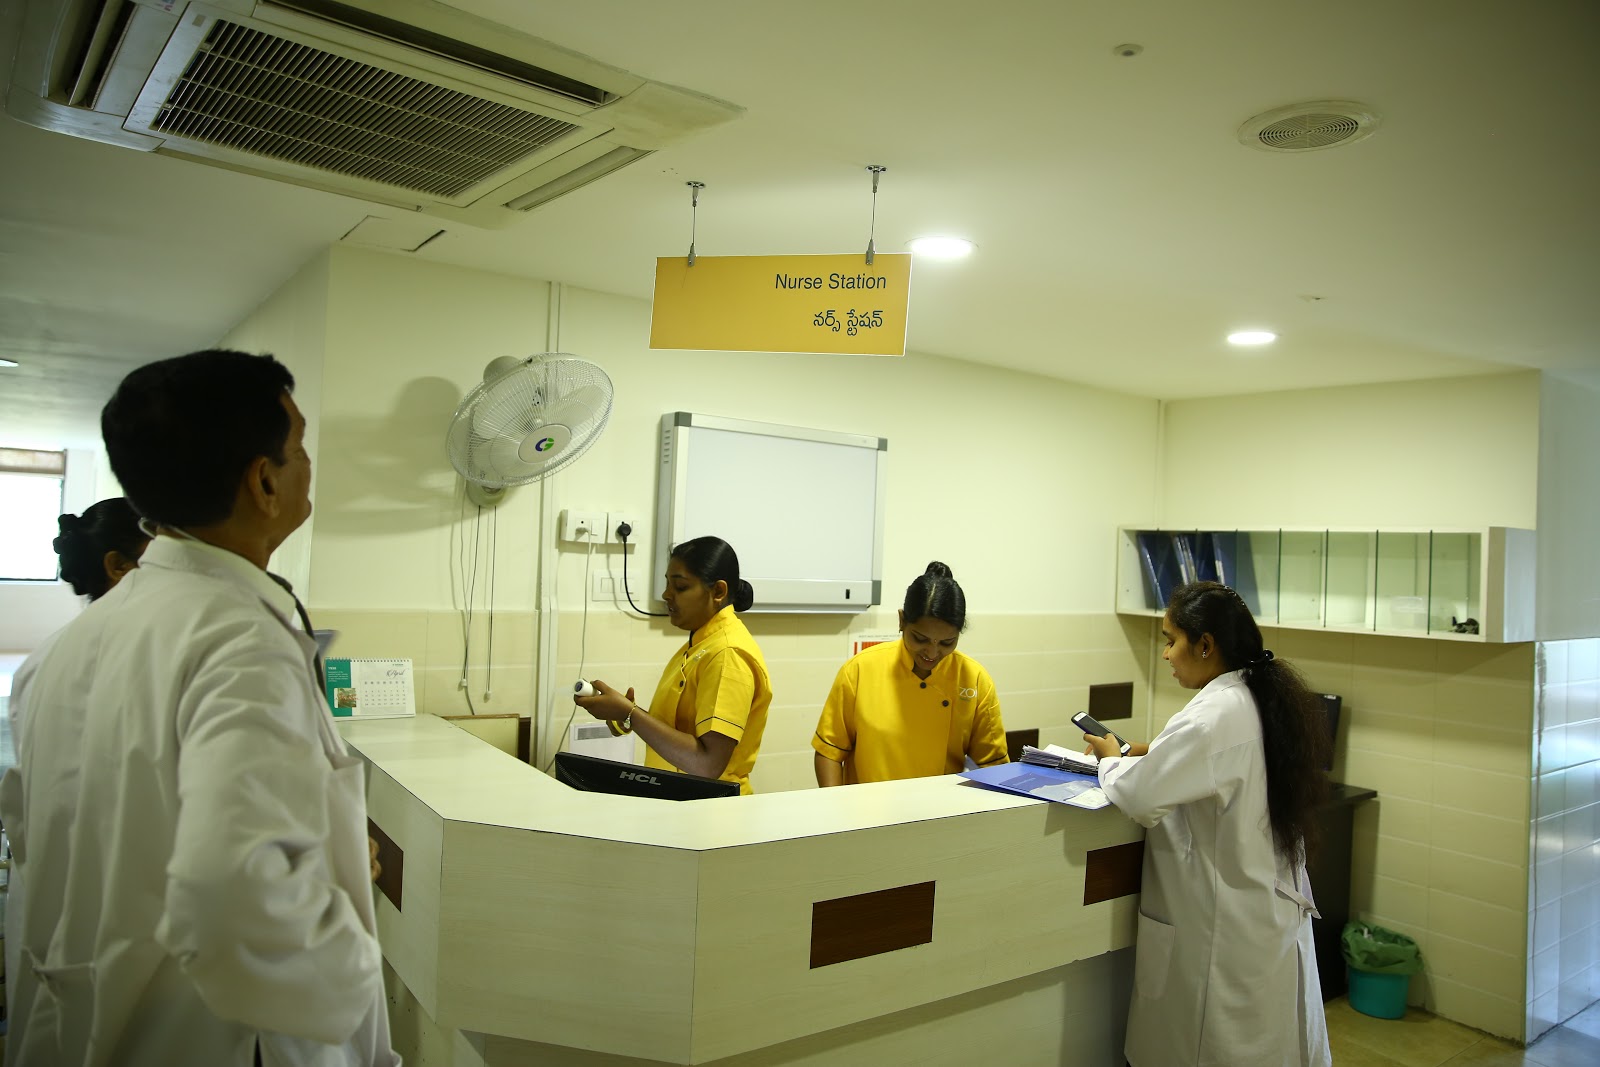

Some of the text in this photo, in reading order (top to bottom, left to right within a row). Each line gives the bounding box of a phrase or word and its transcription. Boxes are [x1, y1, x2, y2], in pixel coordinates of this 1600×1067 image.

[775, 272, 887, 290] Nurse Station
[813, 308, 884, 337] నర్స్ స్టేషన్
[619, 770, 662, 786] HCL
